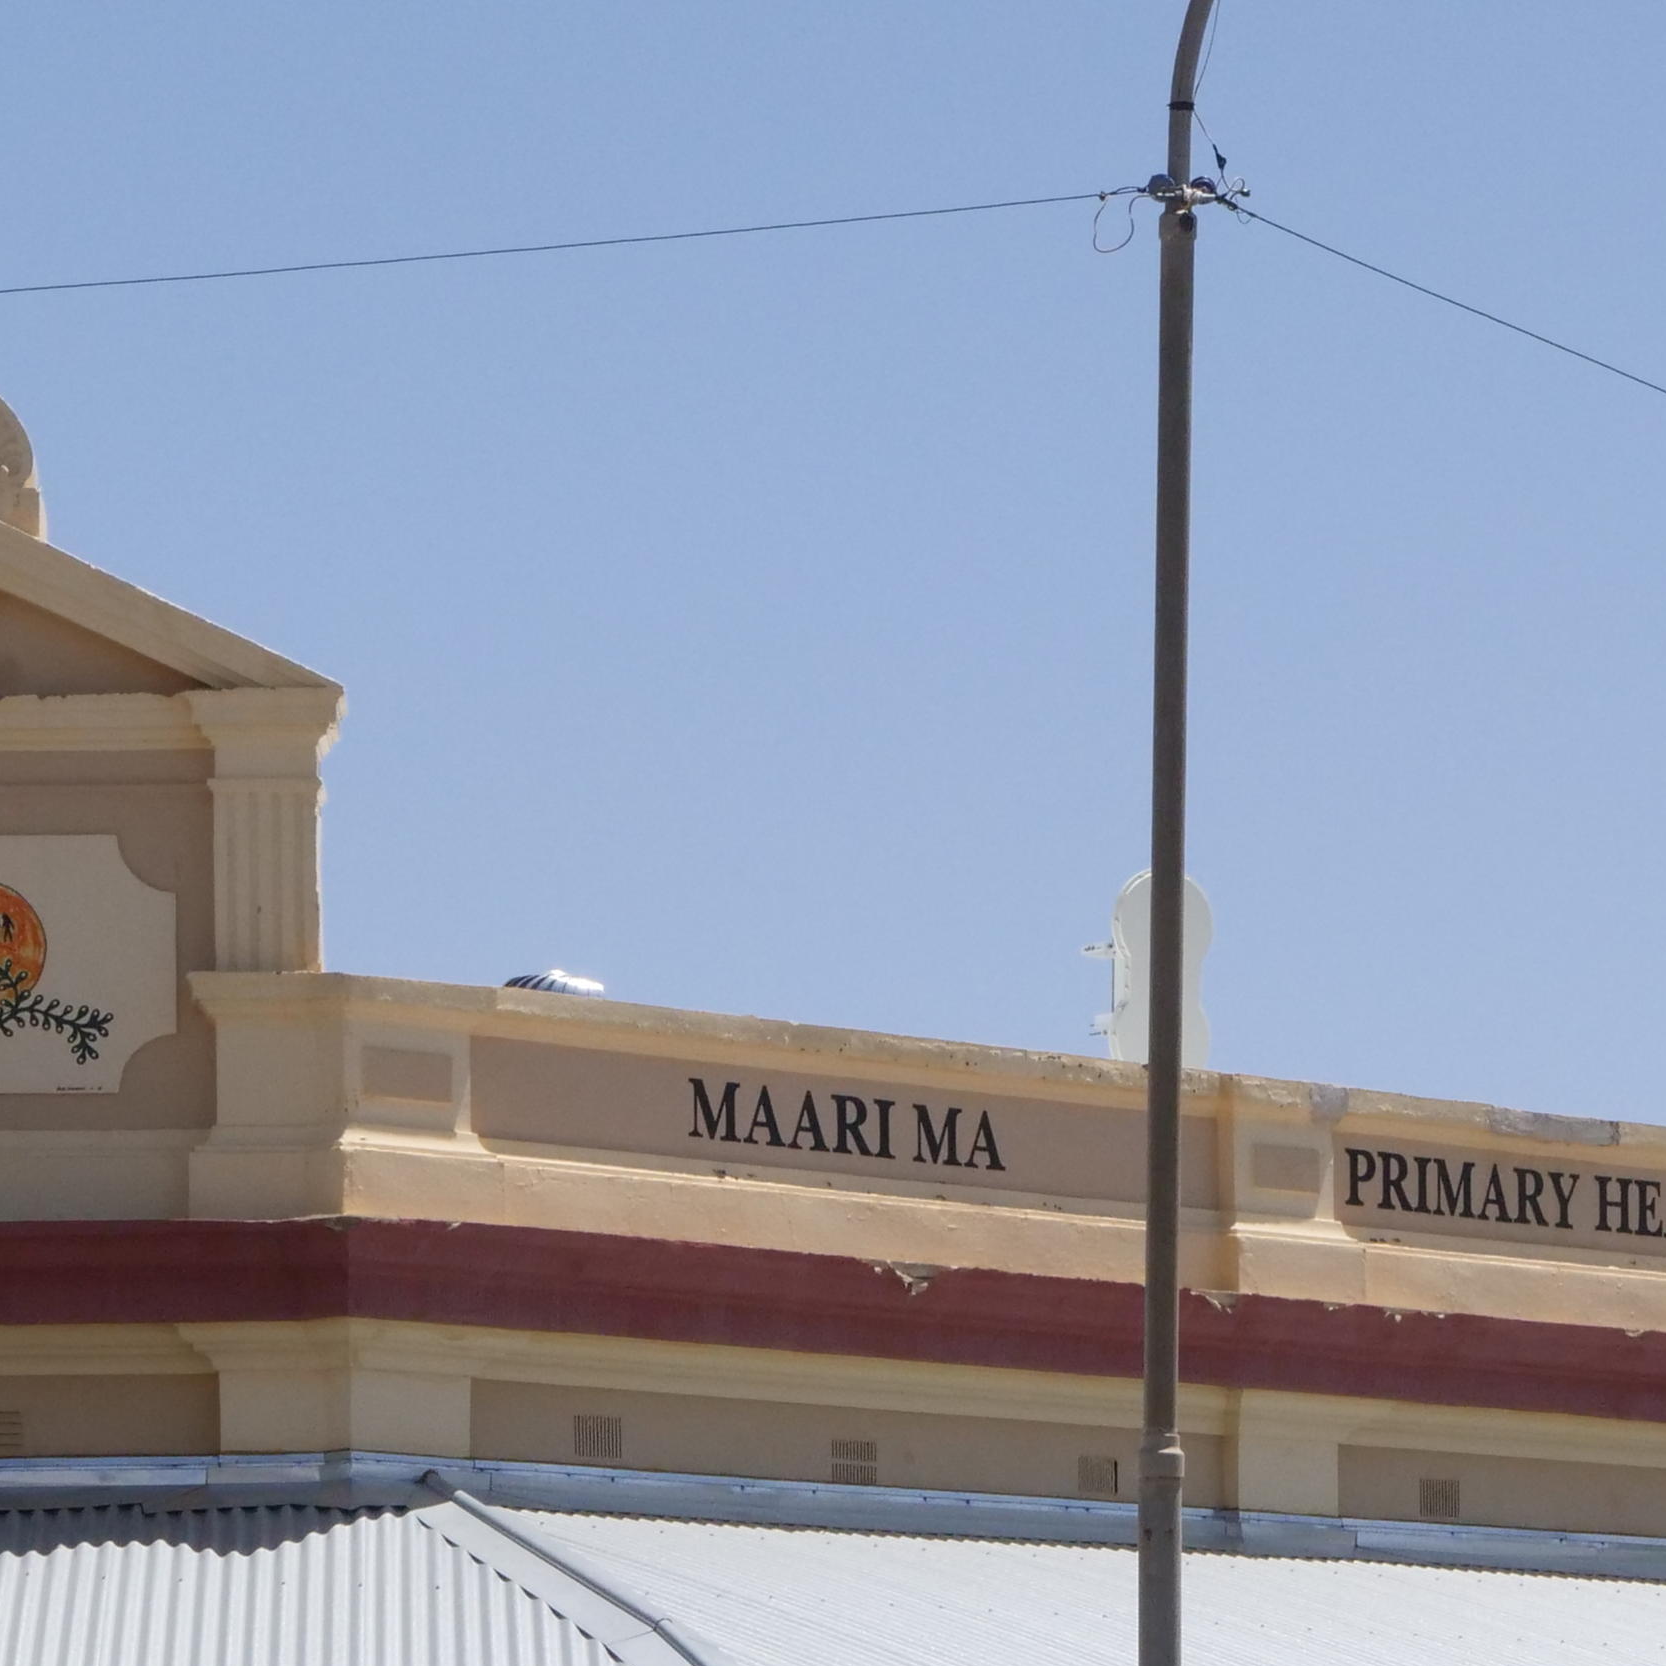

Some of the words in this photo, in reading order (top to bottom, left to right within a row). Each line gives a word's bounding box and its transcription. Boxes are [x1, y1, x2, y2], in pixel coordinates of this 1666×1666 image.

[688, 1077, 896, 1159] MAARI
[912, 1103, 1006, 1171] MA
[1344, 1147, 1580, 1230] PRIMARY
